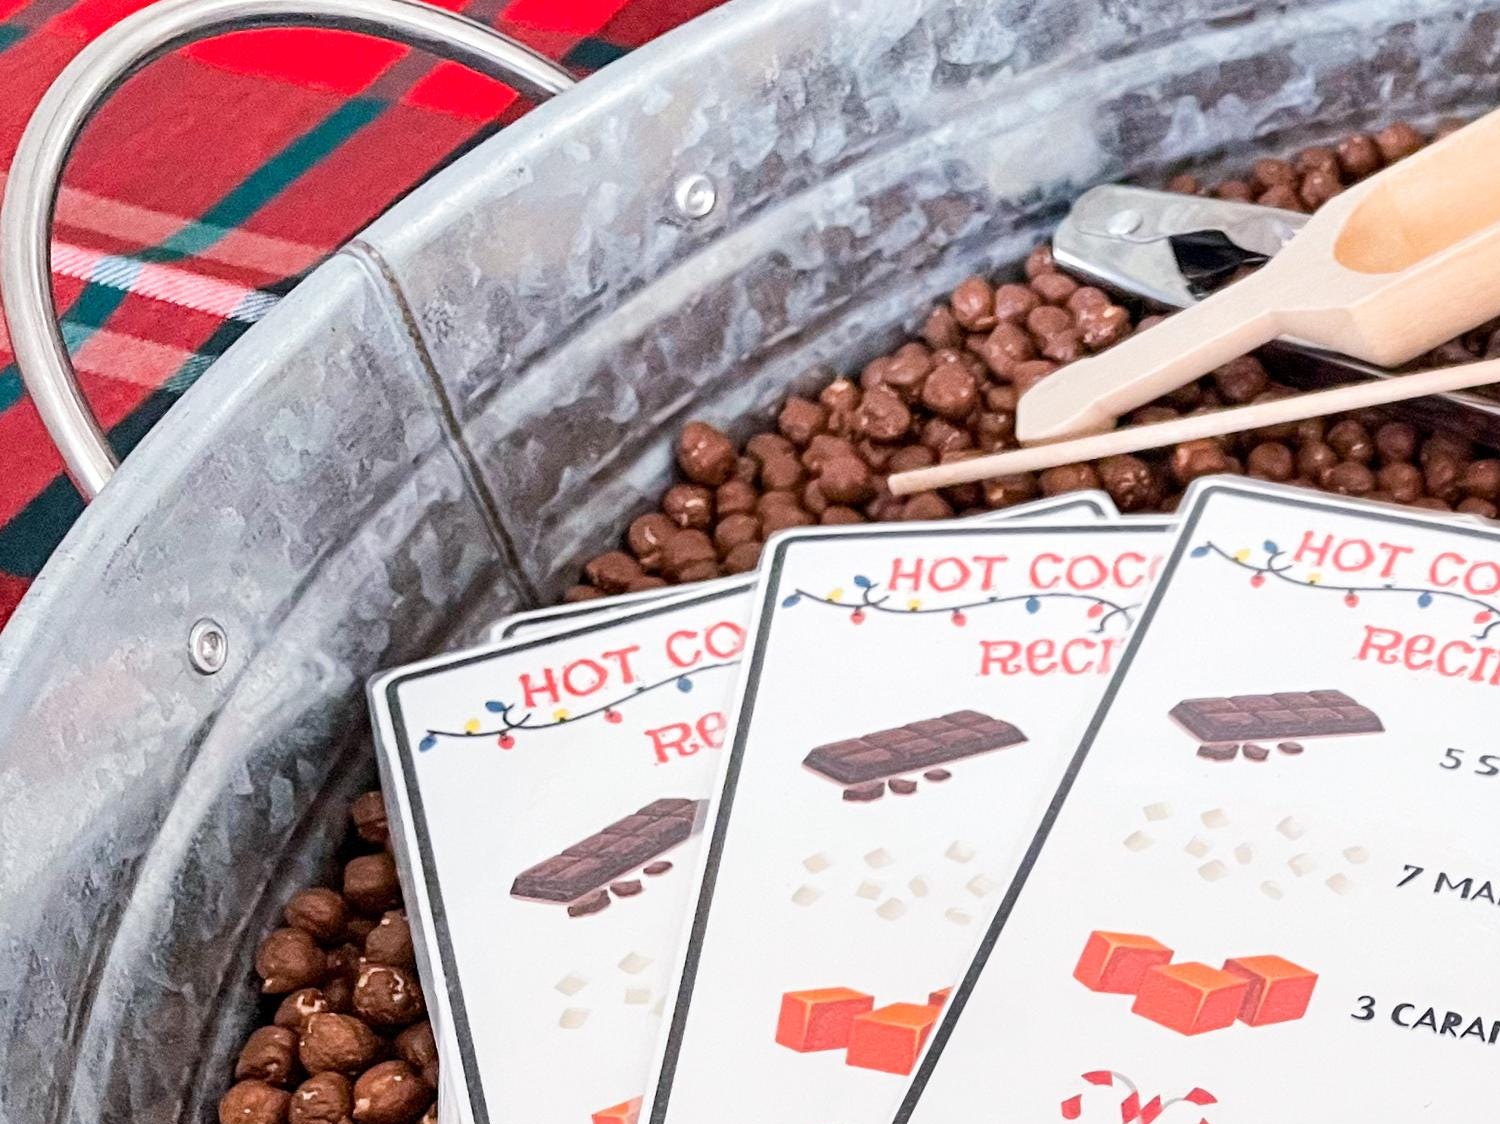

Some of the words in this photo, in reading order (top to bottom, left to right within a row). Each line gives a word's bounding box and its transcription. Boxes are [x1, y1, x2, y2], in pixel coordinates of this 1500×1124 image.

[1292, 530, 1414, 578] HOT
[887, 554, 1009, 592] HOT
[518, 643, 640, 708] HOT
[1439, 747, 1463, 772] 5
[1396, 863, 1424, 888] 7
[1350, 995, 1376, 1021] 3
